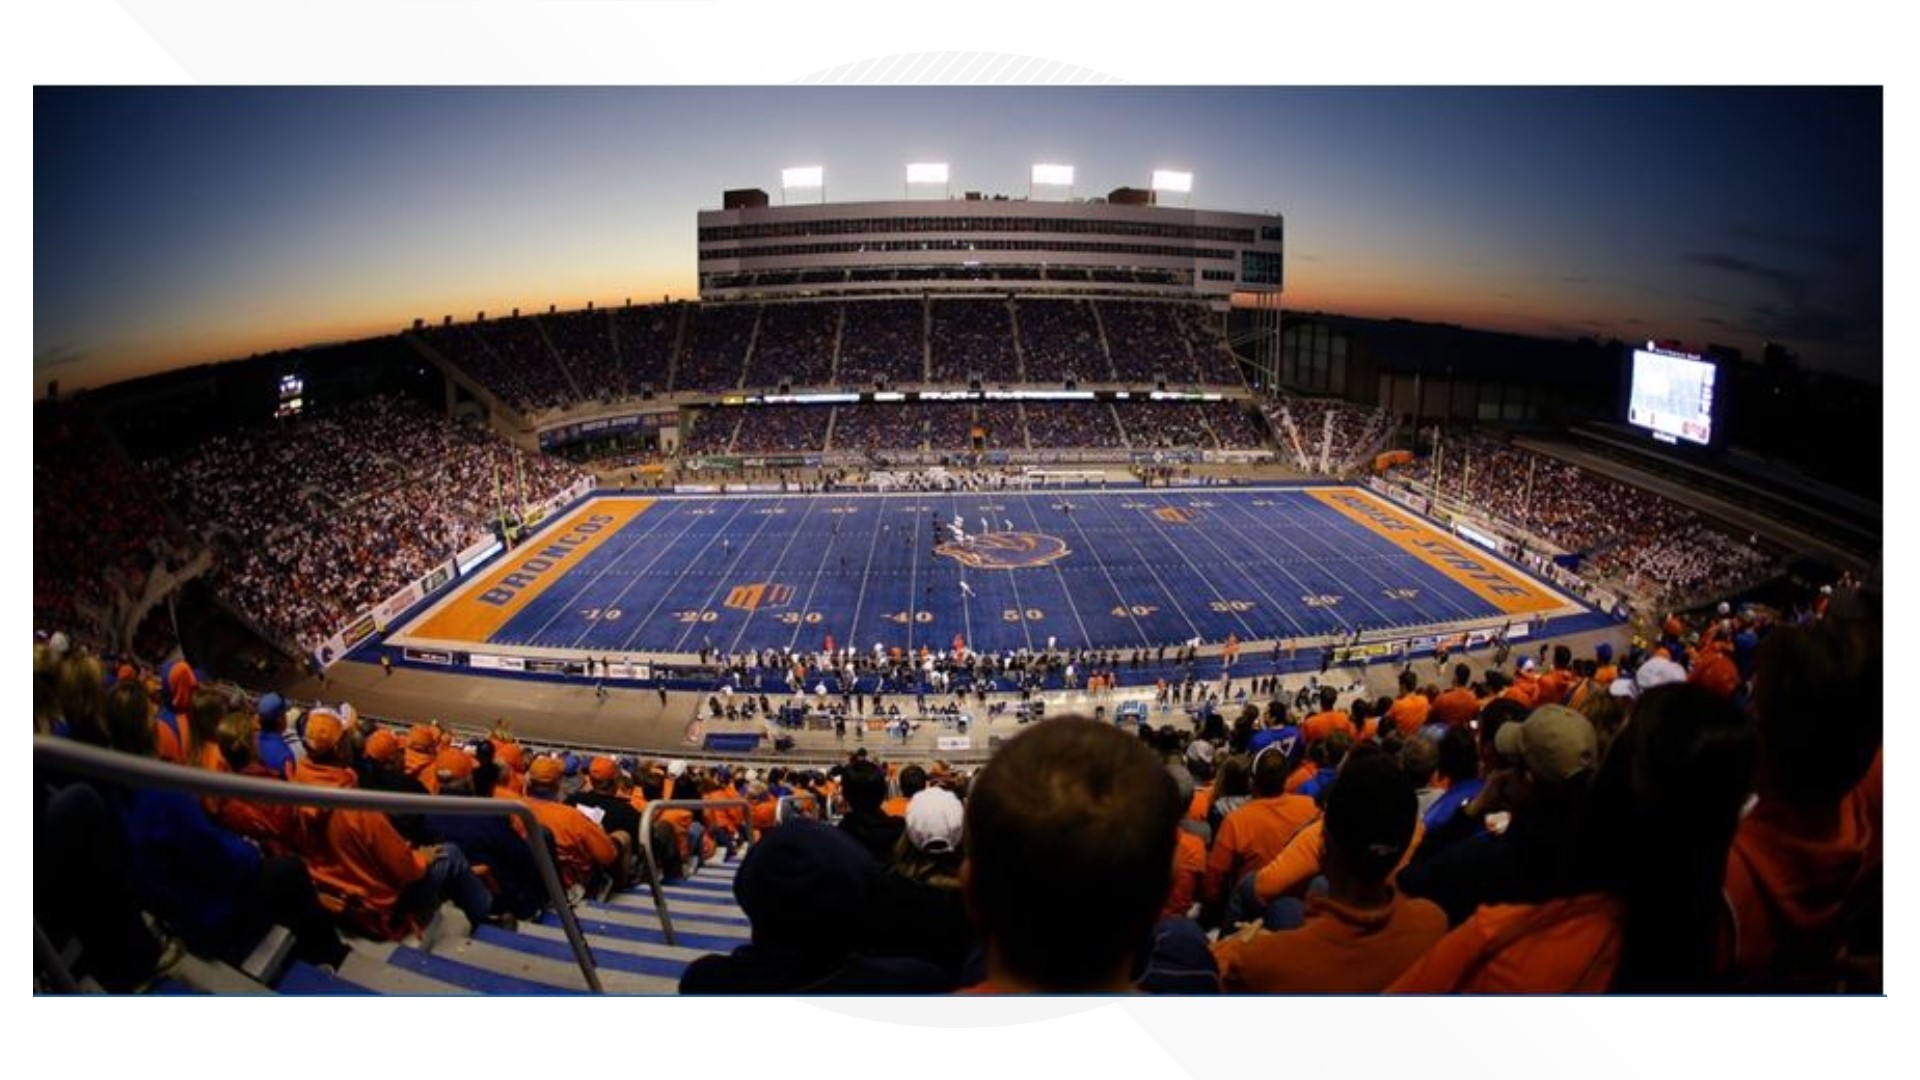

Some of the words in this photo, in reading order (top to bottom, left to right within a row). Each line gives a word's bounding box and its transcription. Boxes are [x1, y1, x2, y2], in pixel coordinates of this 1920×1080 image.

[478, 514, 615, 607] BRONCOS
[1413, 537, 1533, 600] STATE
[587, 608, 622, 620] 10
[680, 610, 719, 623] 20
[782, 611, 823, 624] 30
[891, 611, 933, 623] 40
[1003, 608, 1045, 622] 50
[1111, 604, 1151, 618] 40
